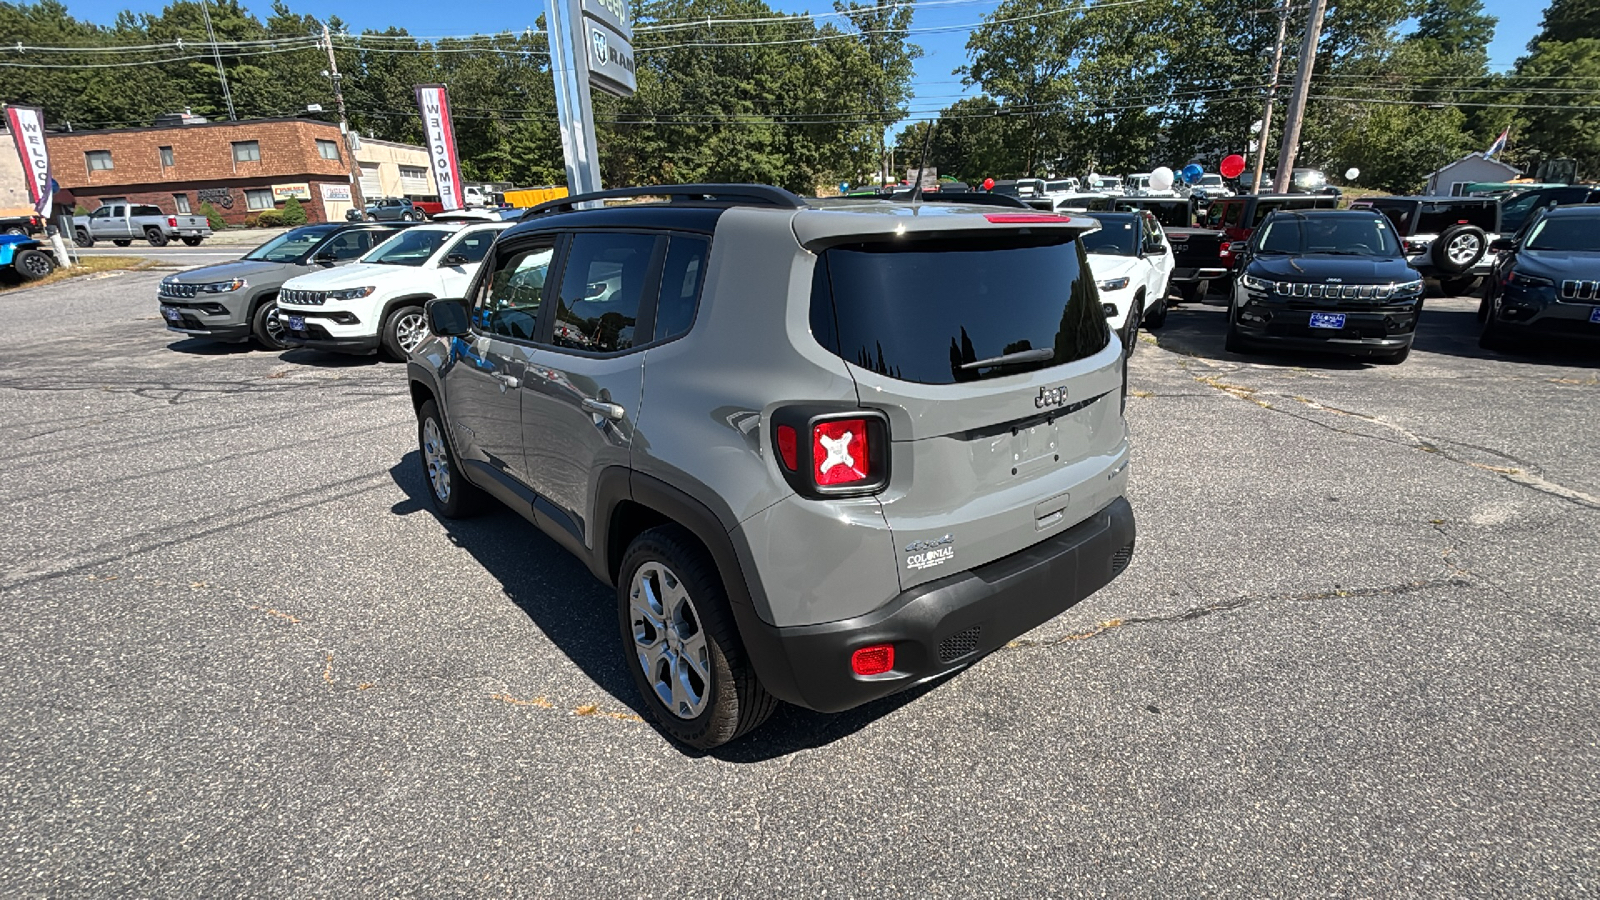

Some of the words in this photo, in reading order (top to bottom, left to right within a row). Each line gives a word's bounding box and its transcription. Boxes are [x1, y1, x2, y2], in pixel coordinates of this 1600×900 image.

[609, 46, 634, 74] RAM
[1035, 386, 1068, 408] Jeep
[907, 547, 954, 565] COLONIAL
